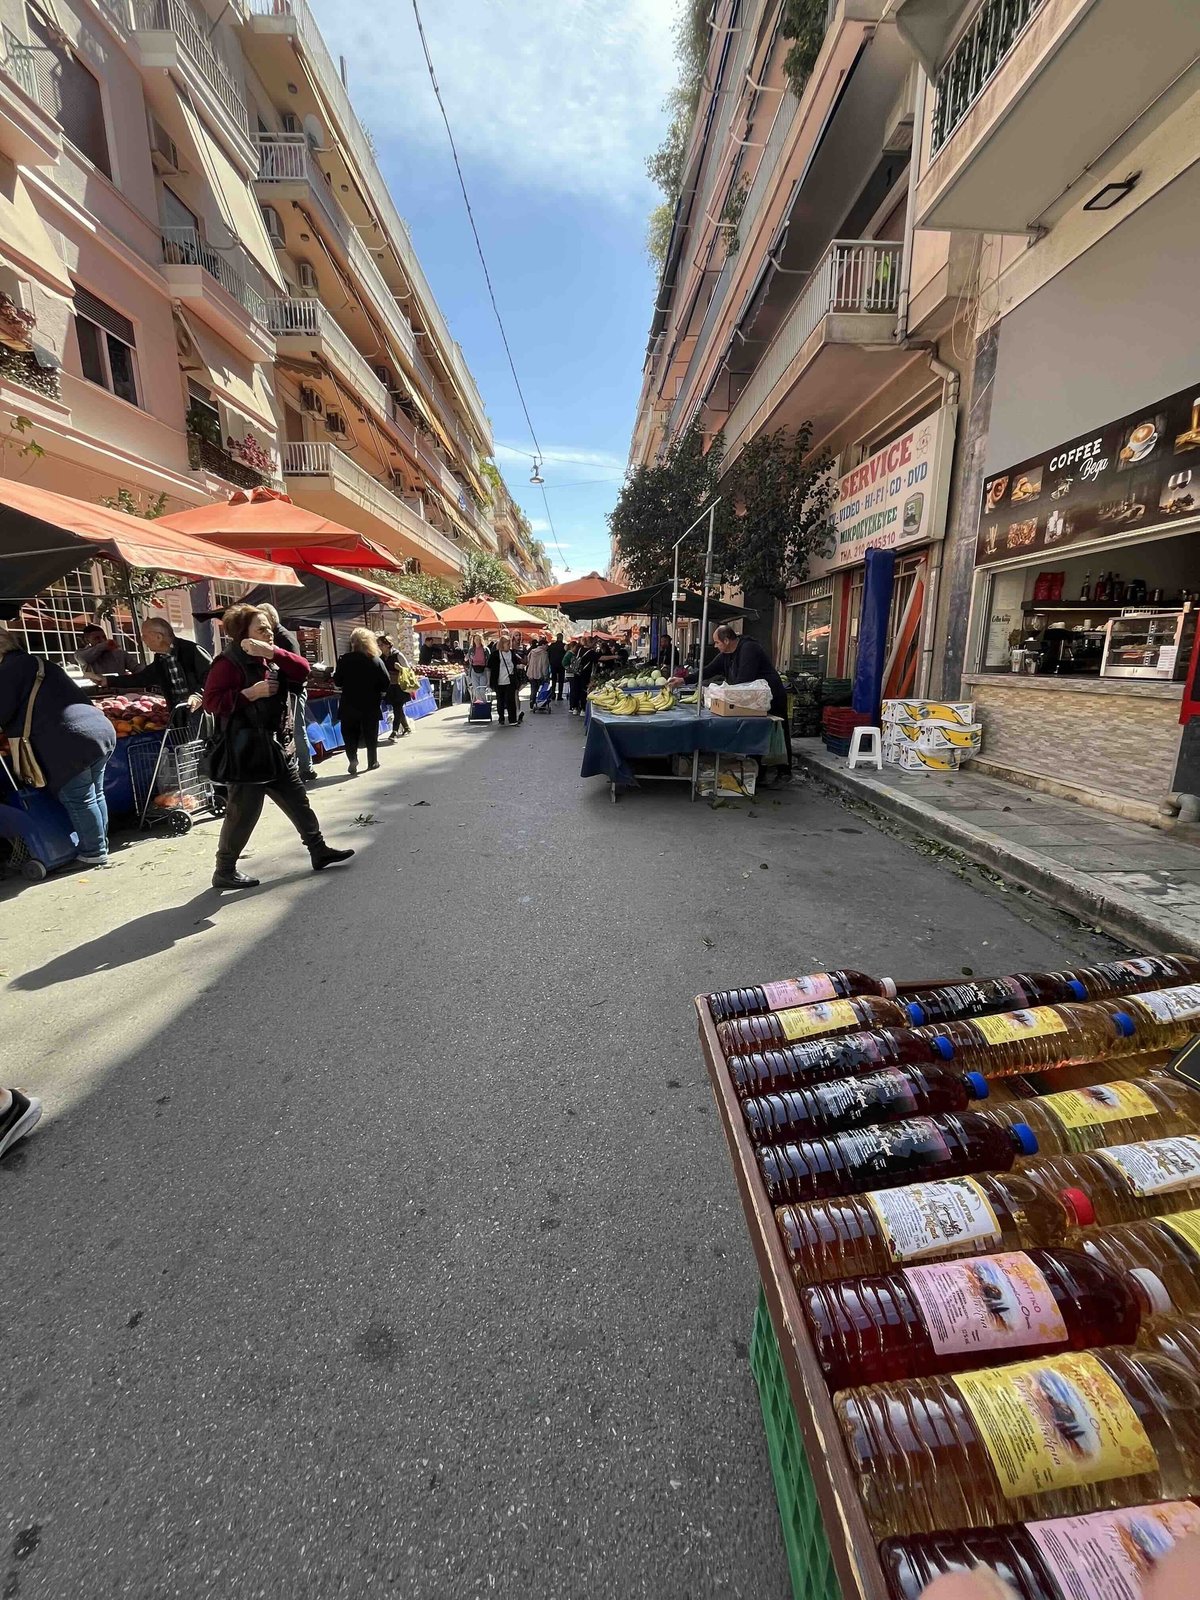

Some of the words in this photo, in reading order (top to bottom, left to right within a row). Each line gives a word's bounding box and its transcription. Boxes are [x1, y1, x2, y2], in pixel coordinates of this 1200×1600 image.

[840, 433, 914, 502] SERVICE
[1049, 437, 1103, 472] COFFEE
[839, 499, 860, 522] VIDEO
[864, 485, 885, 510] HI-FI
[889, 476, 902, 497] CD
[907, 461, 928, 487] DVD
